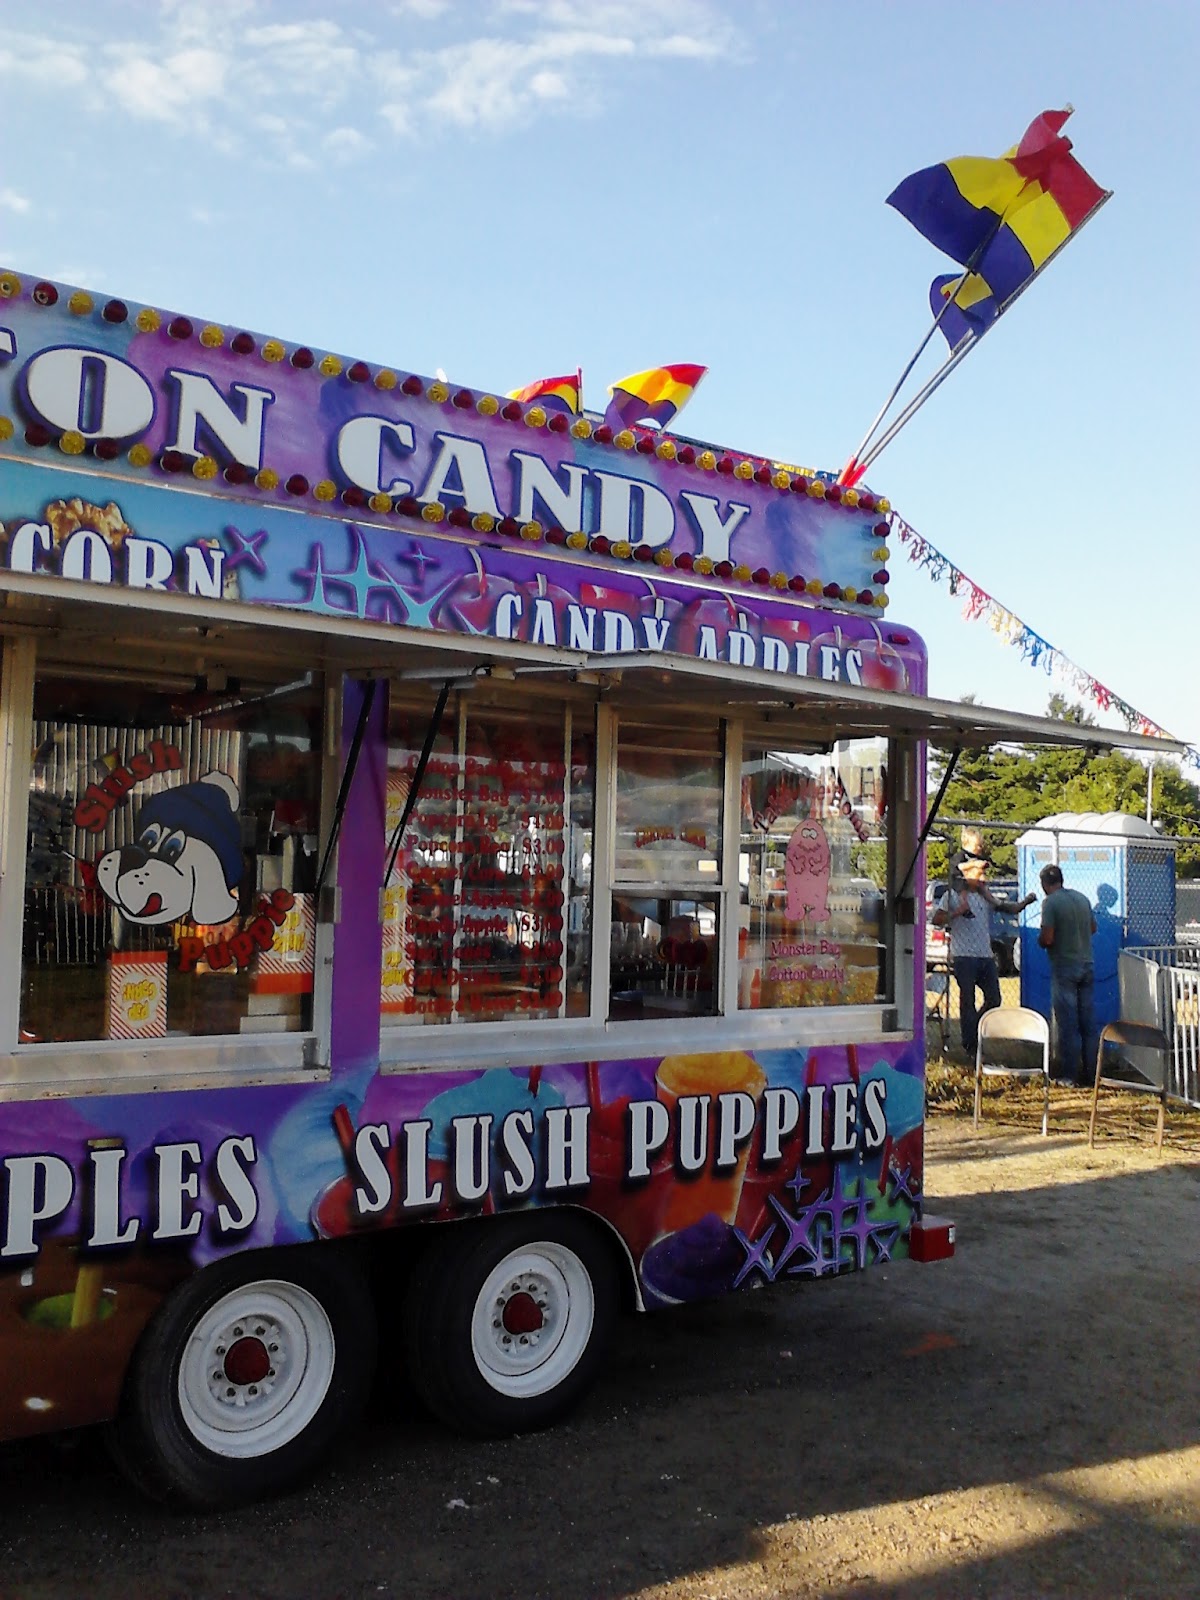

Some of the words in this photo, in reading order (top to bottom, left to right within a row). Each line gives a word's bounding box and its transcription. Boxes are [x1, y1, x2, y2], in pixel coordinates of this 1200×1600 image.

[0, 327, 274, 469] ON
[334, 413, 750, 565] CANDY
[10, 522, 226, 599] CORN
[494, 592, 670, 655] CANDY
[74, 738, 184, 833] Slush
[769, 940, 816, 959] Monster
[355, 1106, 591, 1214] SLUSH
[629, 1079, 887, 1179] PUPPIES
[2, 1136, 259, 1257] PLES
